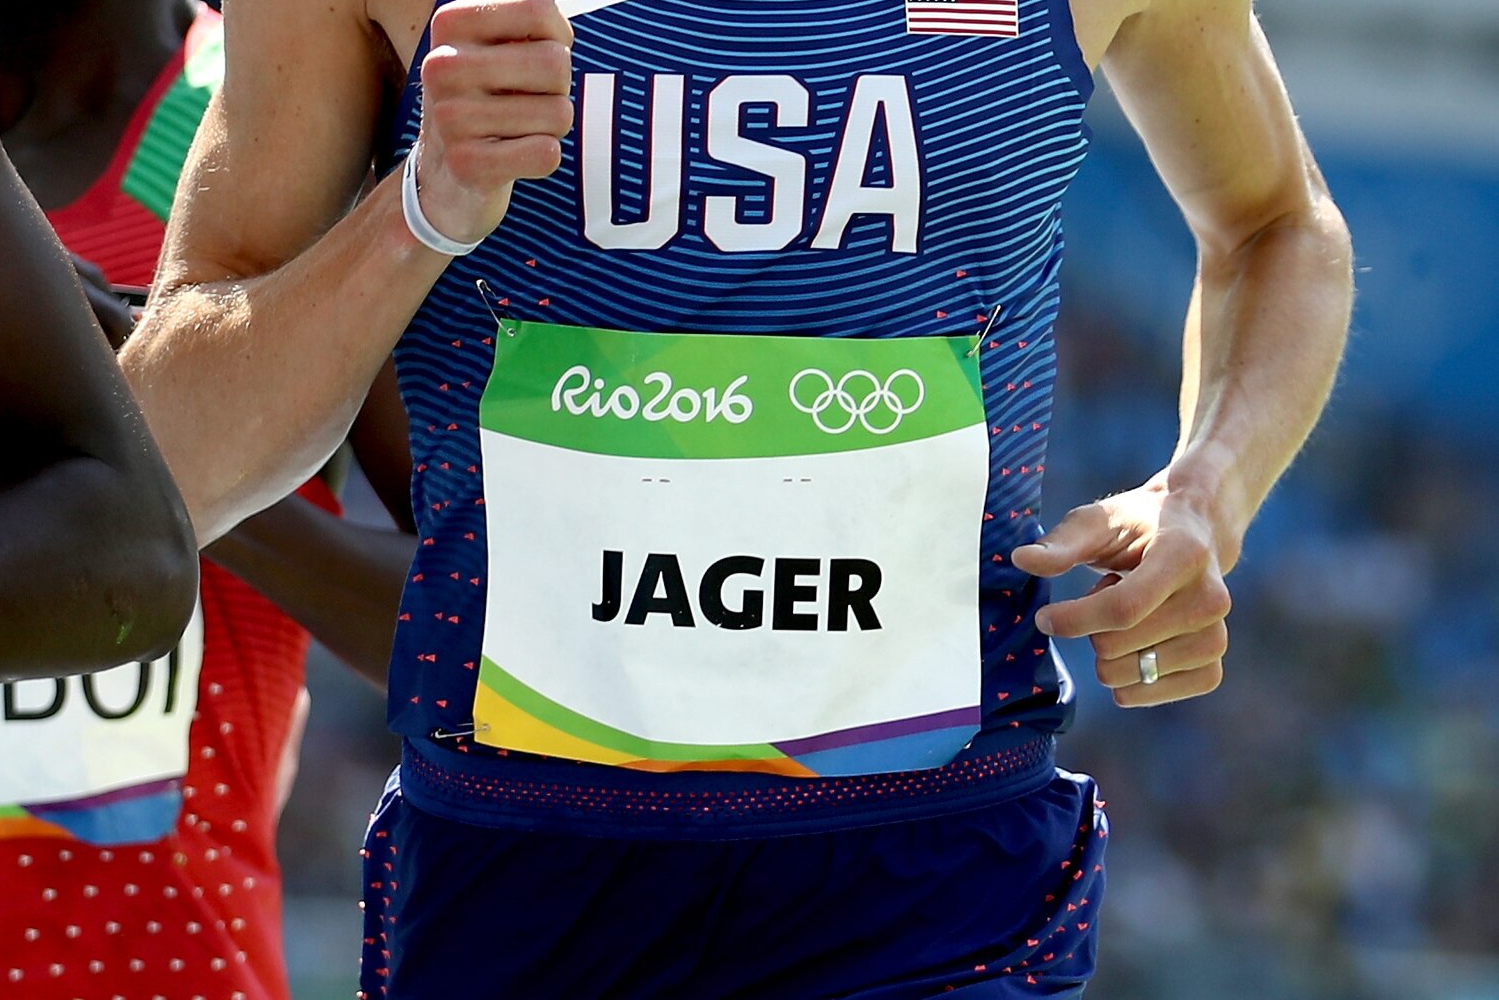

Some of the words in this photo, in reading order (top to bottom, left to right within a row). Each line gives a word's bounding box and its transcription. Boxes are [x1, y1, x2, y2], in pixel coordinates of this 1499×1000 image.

[581, 74, 923, 254] USA
[551, 365, 753, 424] Rio2016
[592, 550, 883, 632] JAGER
